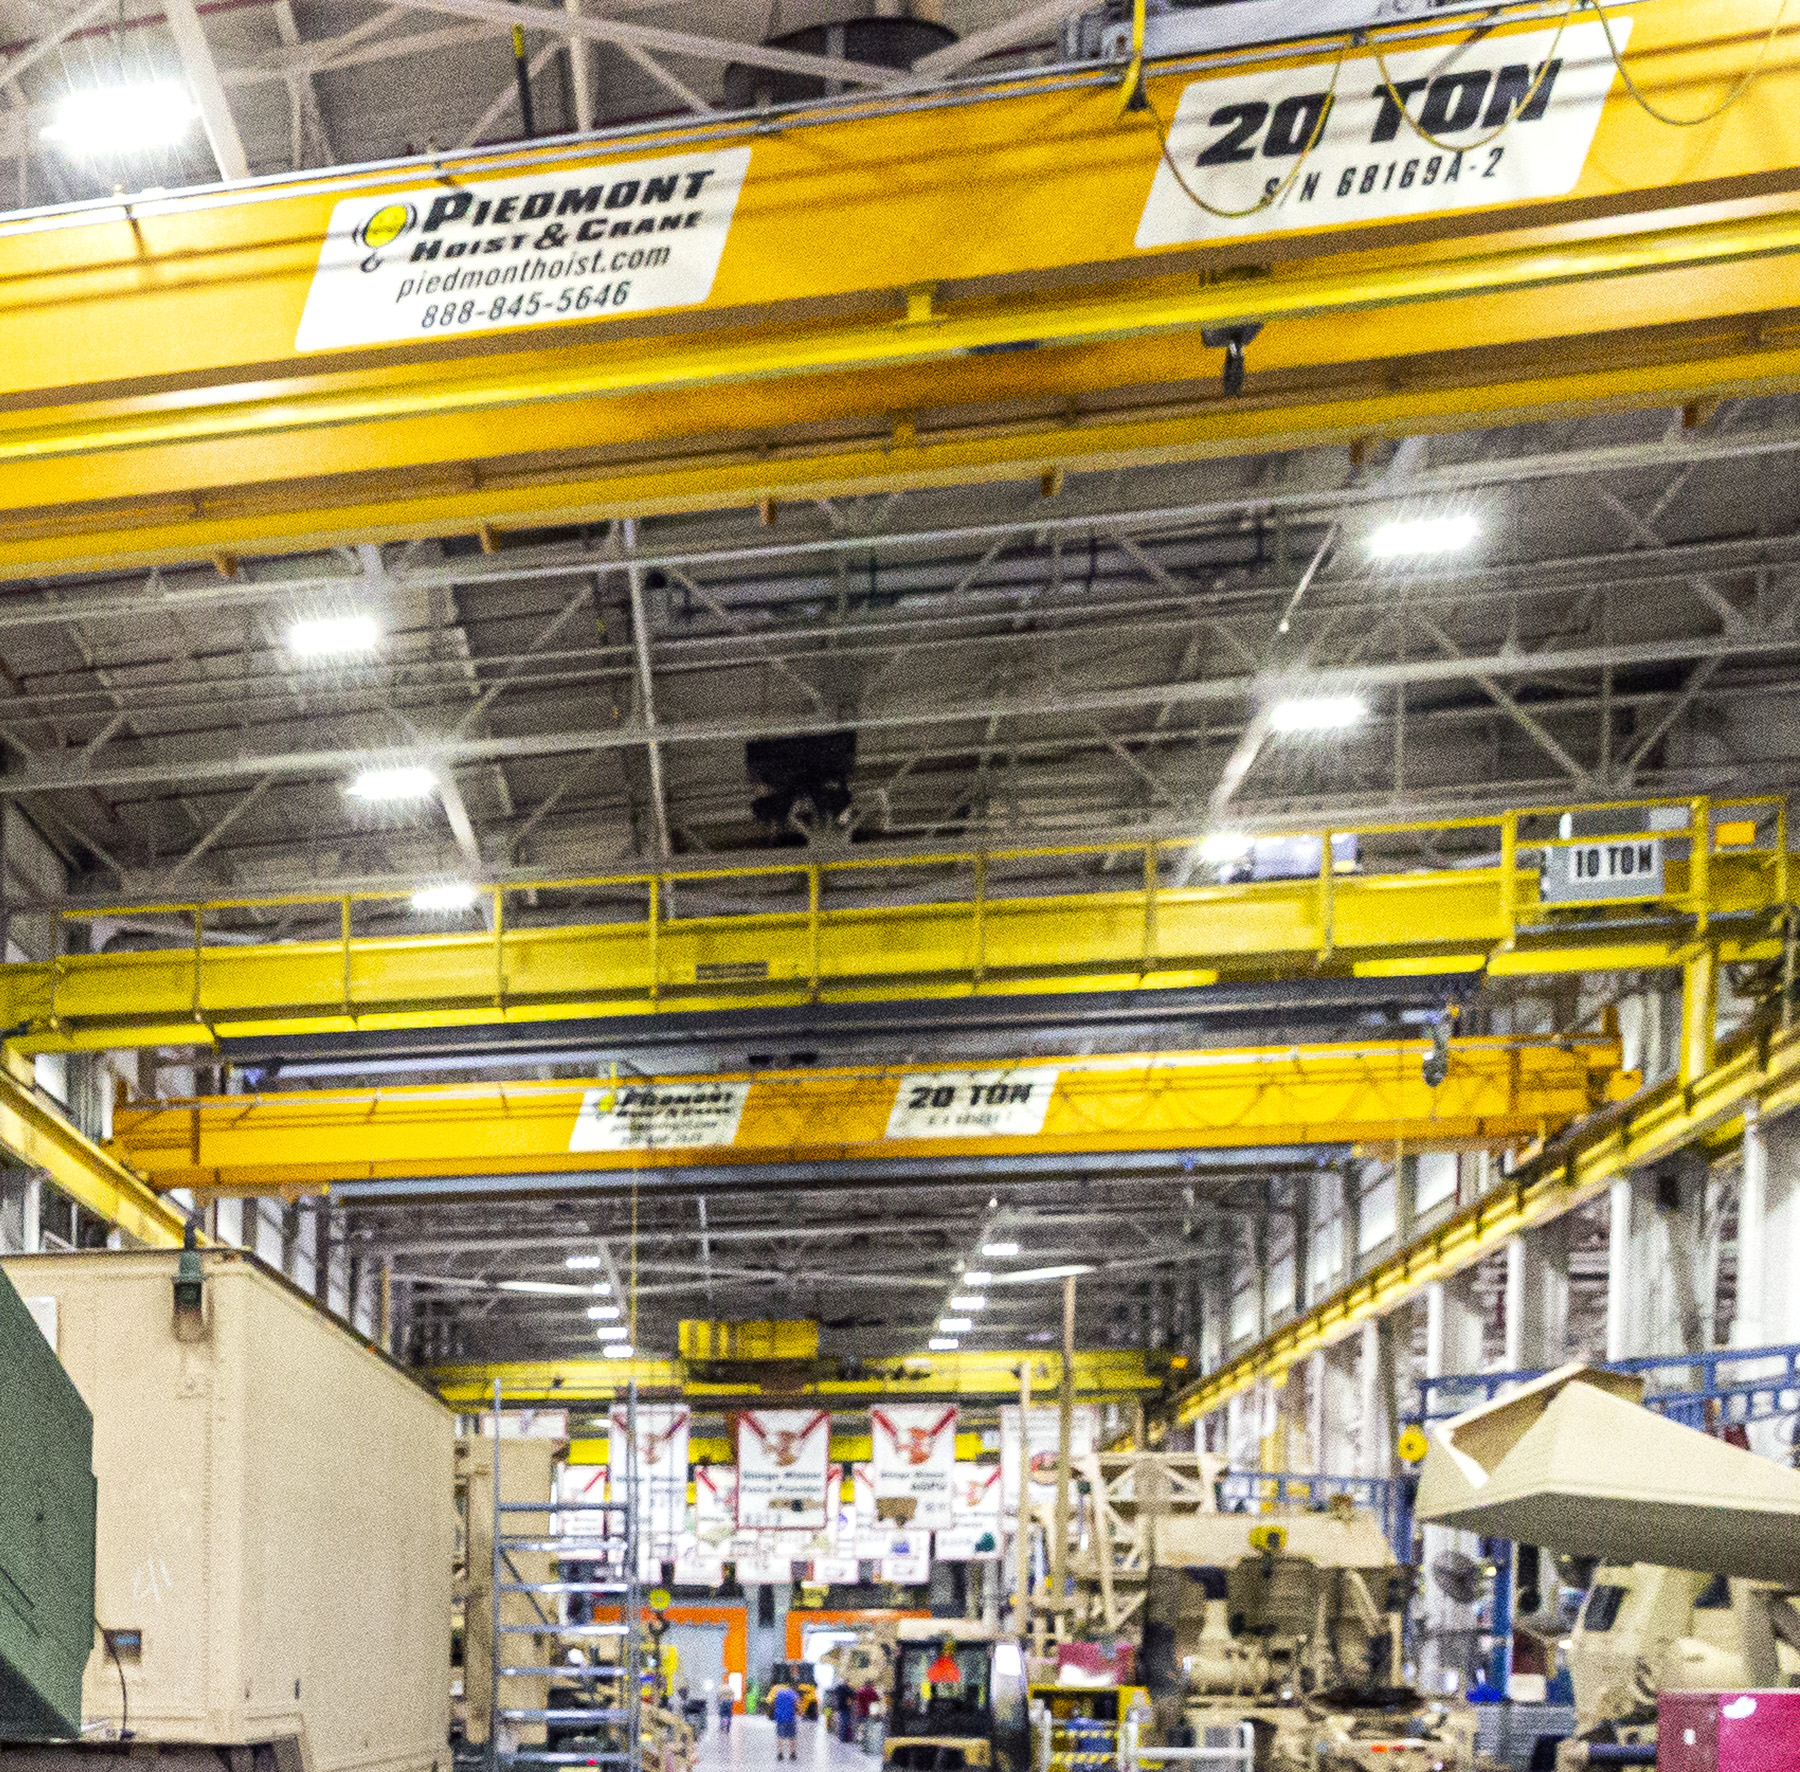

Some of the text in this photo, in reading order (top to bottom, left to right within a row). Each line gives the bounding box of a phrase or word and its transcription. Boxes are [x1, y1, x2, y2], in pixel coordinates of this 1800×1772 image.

[1196, 57, 1564, 167] 20 TON
[422, 169, 714, 233] PIEDMONT
[396, 244, 672, 304] piedmonthoist.com
[420, 280, 634, 330] 888-845-5646
[1607, 844, 1652, 875] TON
[908, 1082, 1034, 1110] 20 TON
